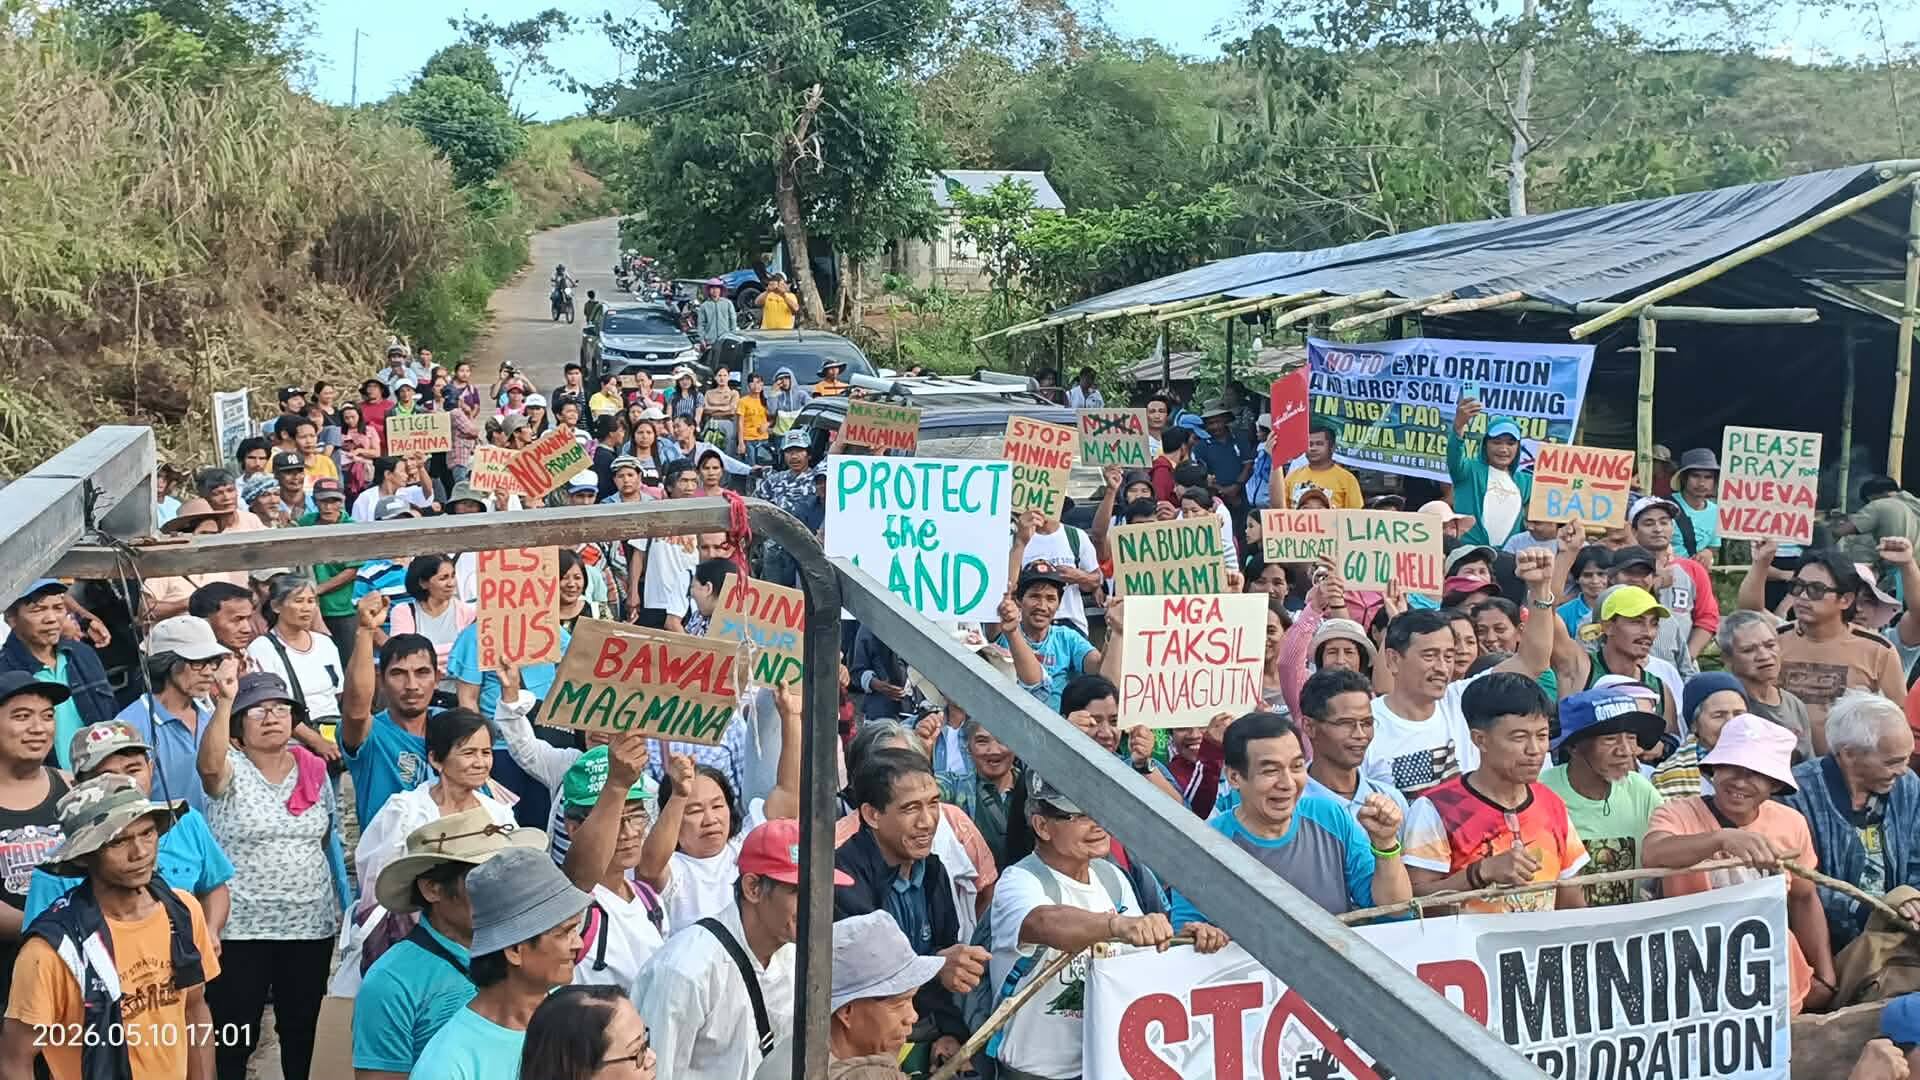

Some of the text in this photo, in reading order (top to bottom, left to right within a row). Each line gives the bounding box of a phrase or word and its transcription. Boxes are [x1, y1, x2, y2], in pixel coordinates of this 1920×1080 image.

[1326, 351, 1550, 386] NO TO EXPLORATION
[1314, 394, 1339, 416] IN
[1400, 403, 1447, 431] PAO,
[1407, 380, 1463, 405] SCAL
[1480, 387, 1565, 415] MINING
[391, 415, 440, 432] ITIGIL
[846, 424, 915, 450] MAGMINA
[1013, 421, 1072, 447] STOP
[1003, 441, 1073, 470] MINING
[1083, 441, 1147, 466] MANA
[1729, 432, 1816, 457] PLEASE
[507, 451, 553, 498] NO
[1537, 449, 1632, 480] MINING
[1730, 455, 1795, 479] PRAY
[837, 460, 1009, 516] PROTECT
[1011, 483, 1060, 515] OME
[1572, 479, 1584, 490] IS
[1722, 479, 1814, 509] NUEVA
[1547, 489, 1613, 522] BAD
[1720, 506, 1809, 538] VIZCAYA
[882, 514, 940, 551] the
[1268, 512, 1326, 534] ITIGIL
[1346, 518, 1430, 543] LIARS
[478, 547, 540, 573] PLS
[1343, 551, 1439, 591] GO TO HELL
[480, 576, 557, 610] PRAY
[852, 551, 989, 616] AND
[1124, 561, 1220, 595] MO KAMI
[1163, 597, 1223, 626] MGA
[503, 610, 555, 662] US
[1138, 626, 1261, 668] TAKSIL
[593, 637, 735, 697] BAWAL
[1123, 668, 1263, 716] PANAGUTIN
[547, 680, 734, 741] MAGMINA
[1499, 918, 1771, 1046] MINING
